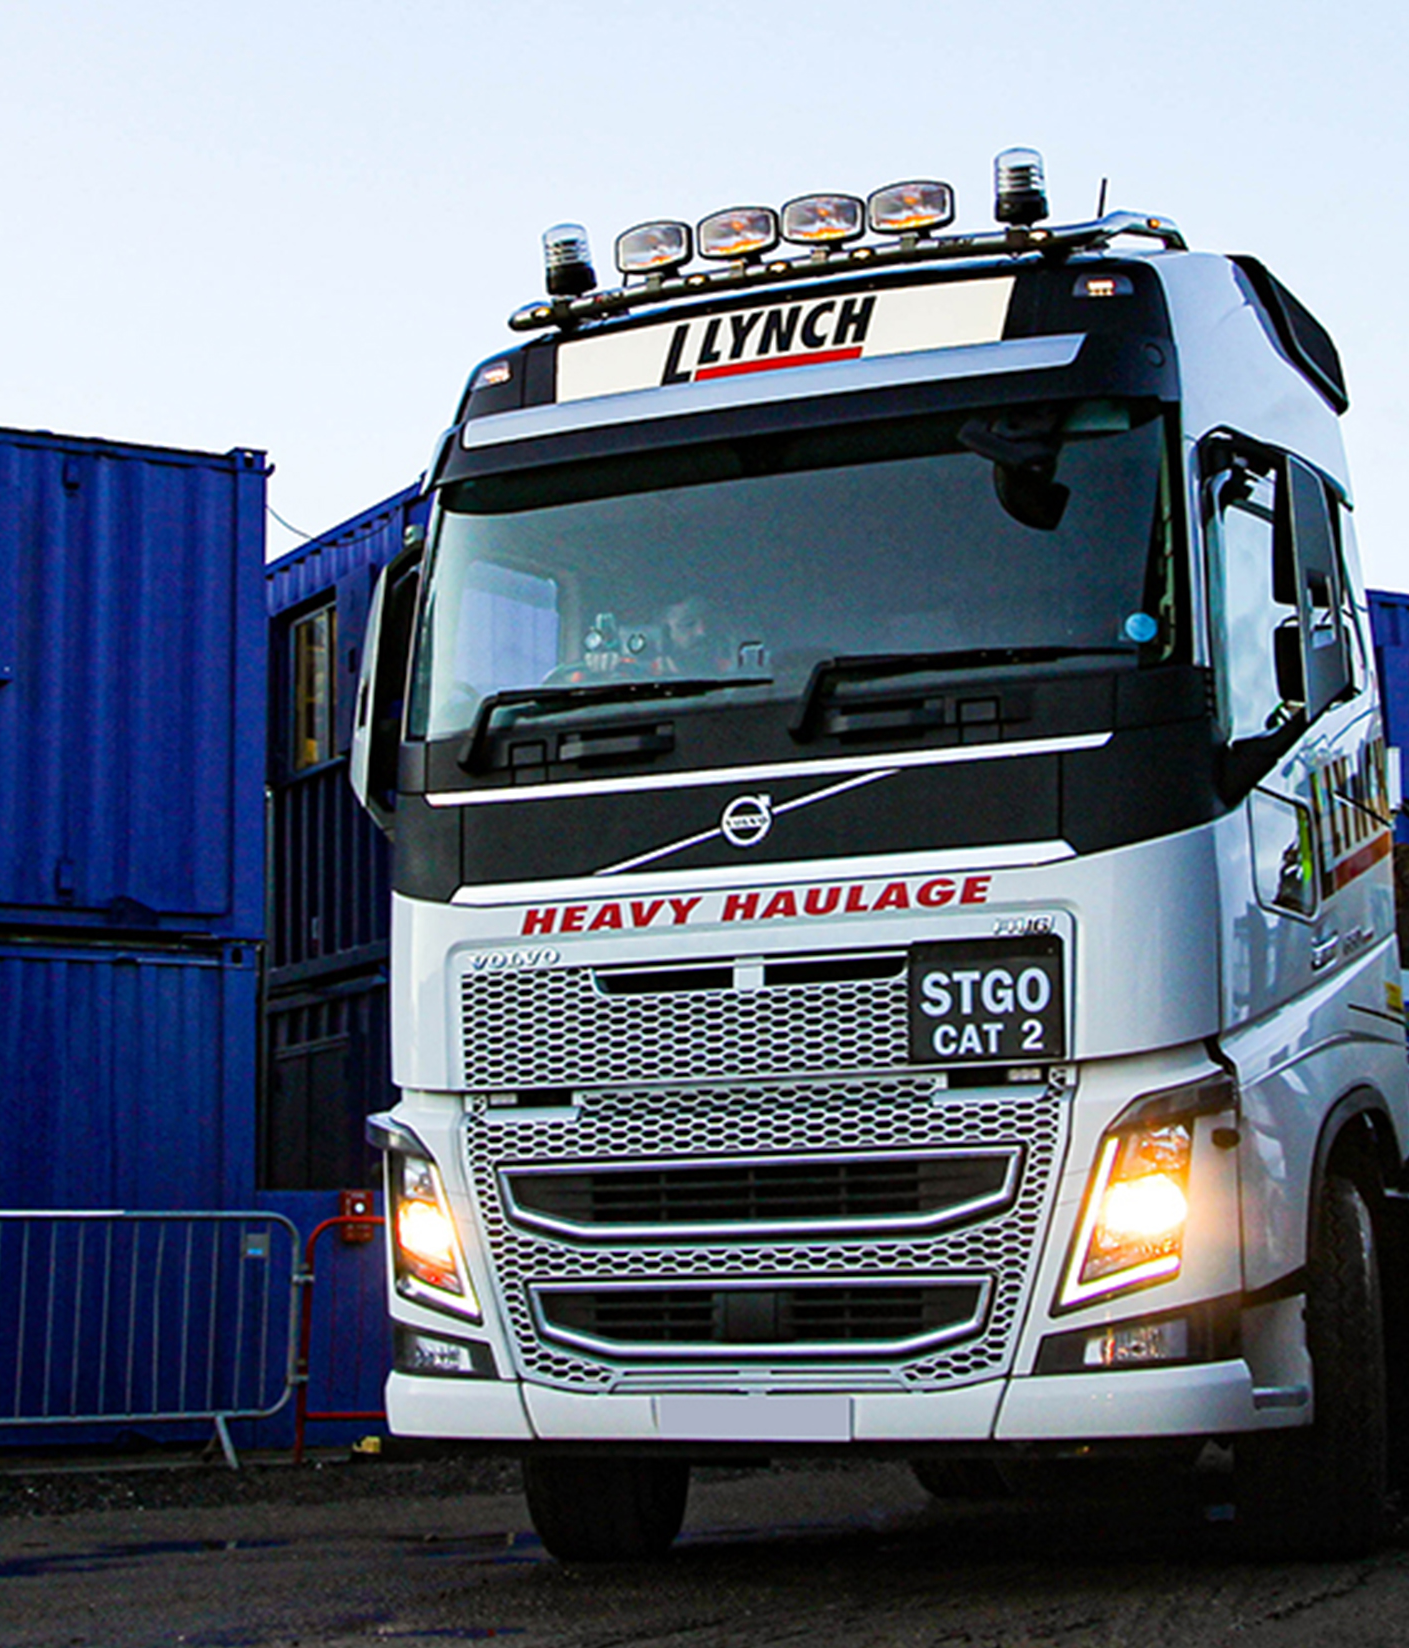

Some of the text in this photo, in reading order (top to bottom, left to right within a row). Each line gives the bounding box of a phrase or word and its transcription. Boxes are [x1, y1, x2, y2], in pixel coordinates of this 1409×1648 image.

[521, 875, 991, 936] HEAVY HAULAGE
[472, 946, 561, 970] VOLVO
[920, 967, 1051, 1017] STGO
[933, 1019, 1044, 1056] CAT 2
